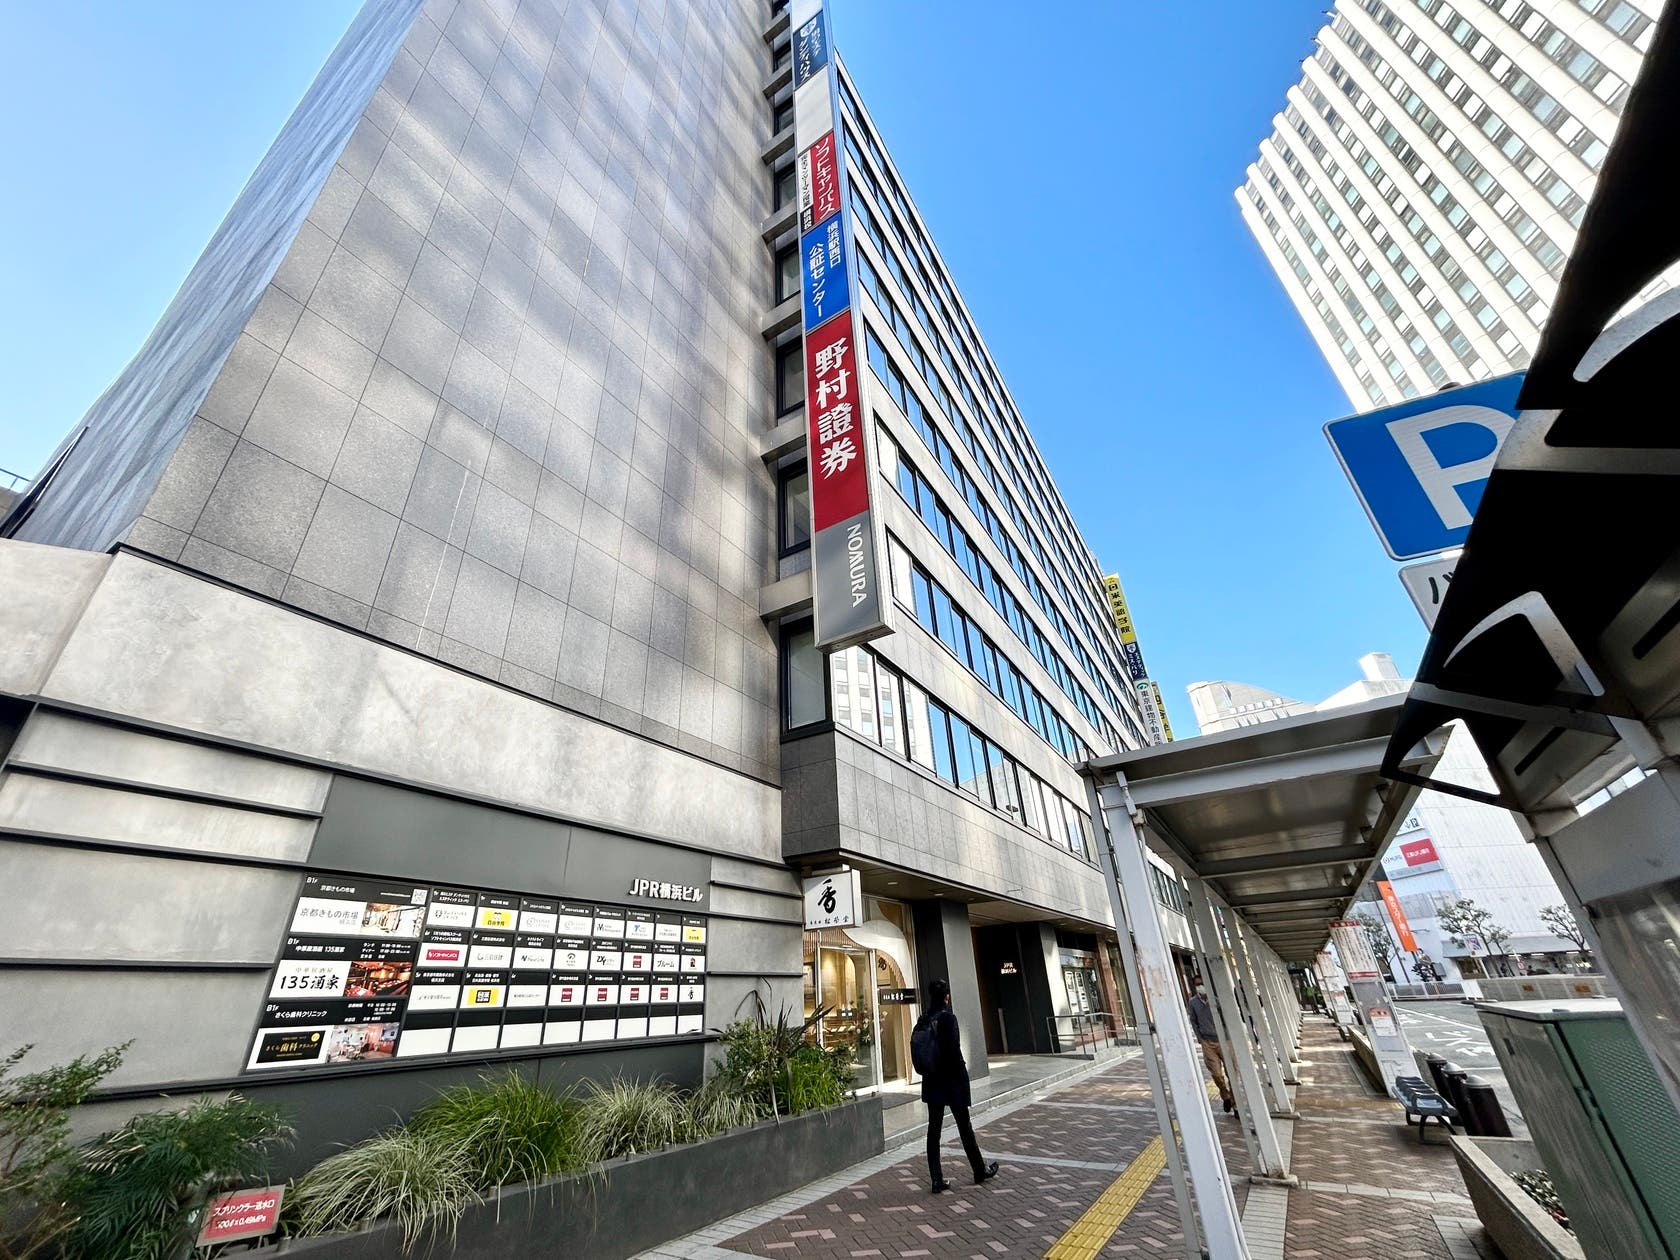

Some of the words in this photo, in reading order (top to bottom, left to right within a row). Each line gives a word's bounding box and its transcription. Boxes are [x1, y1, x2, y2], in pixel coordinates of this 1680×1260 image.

[799, 37, 811, 82] ダンディハウス
[816, 137, 835, 220] ソフトキャンパス
[827, 220, 841, 268] 横浜駅西口
[809, 242, 825, 318] 公証センター
[815, 337, 857, 480] 野村證券
[1385, 405, 1518, 530] P
[847, 522, 868, 608] NOMURA
[629, 878, 704, 902] JPR横浜ビル
[300, 908, 359, 920] 京都きもの市場
[280, 974, 340, 991] 135酒家
[275, 1011, 327, 1019] さくら歯科クリニック
[213, 1199, 275, 1217] スプリンクラー送水口
